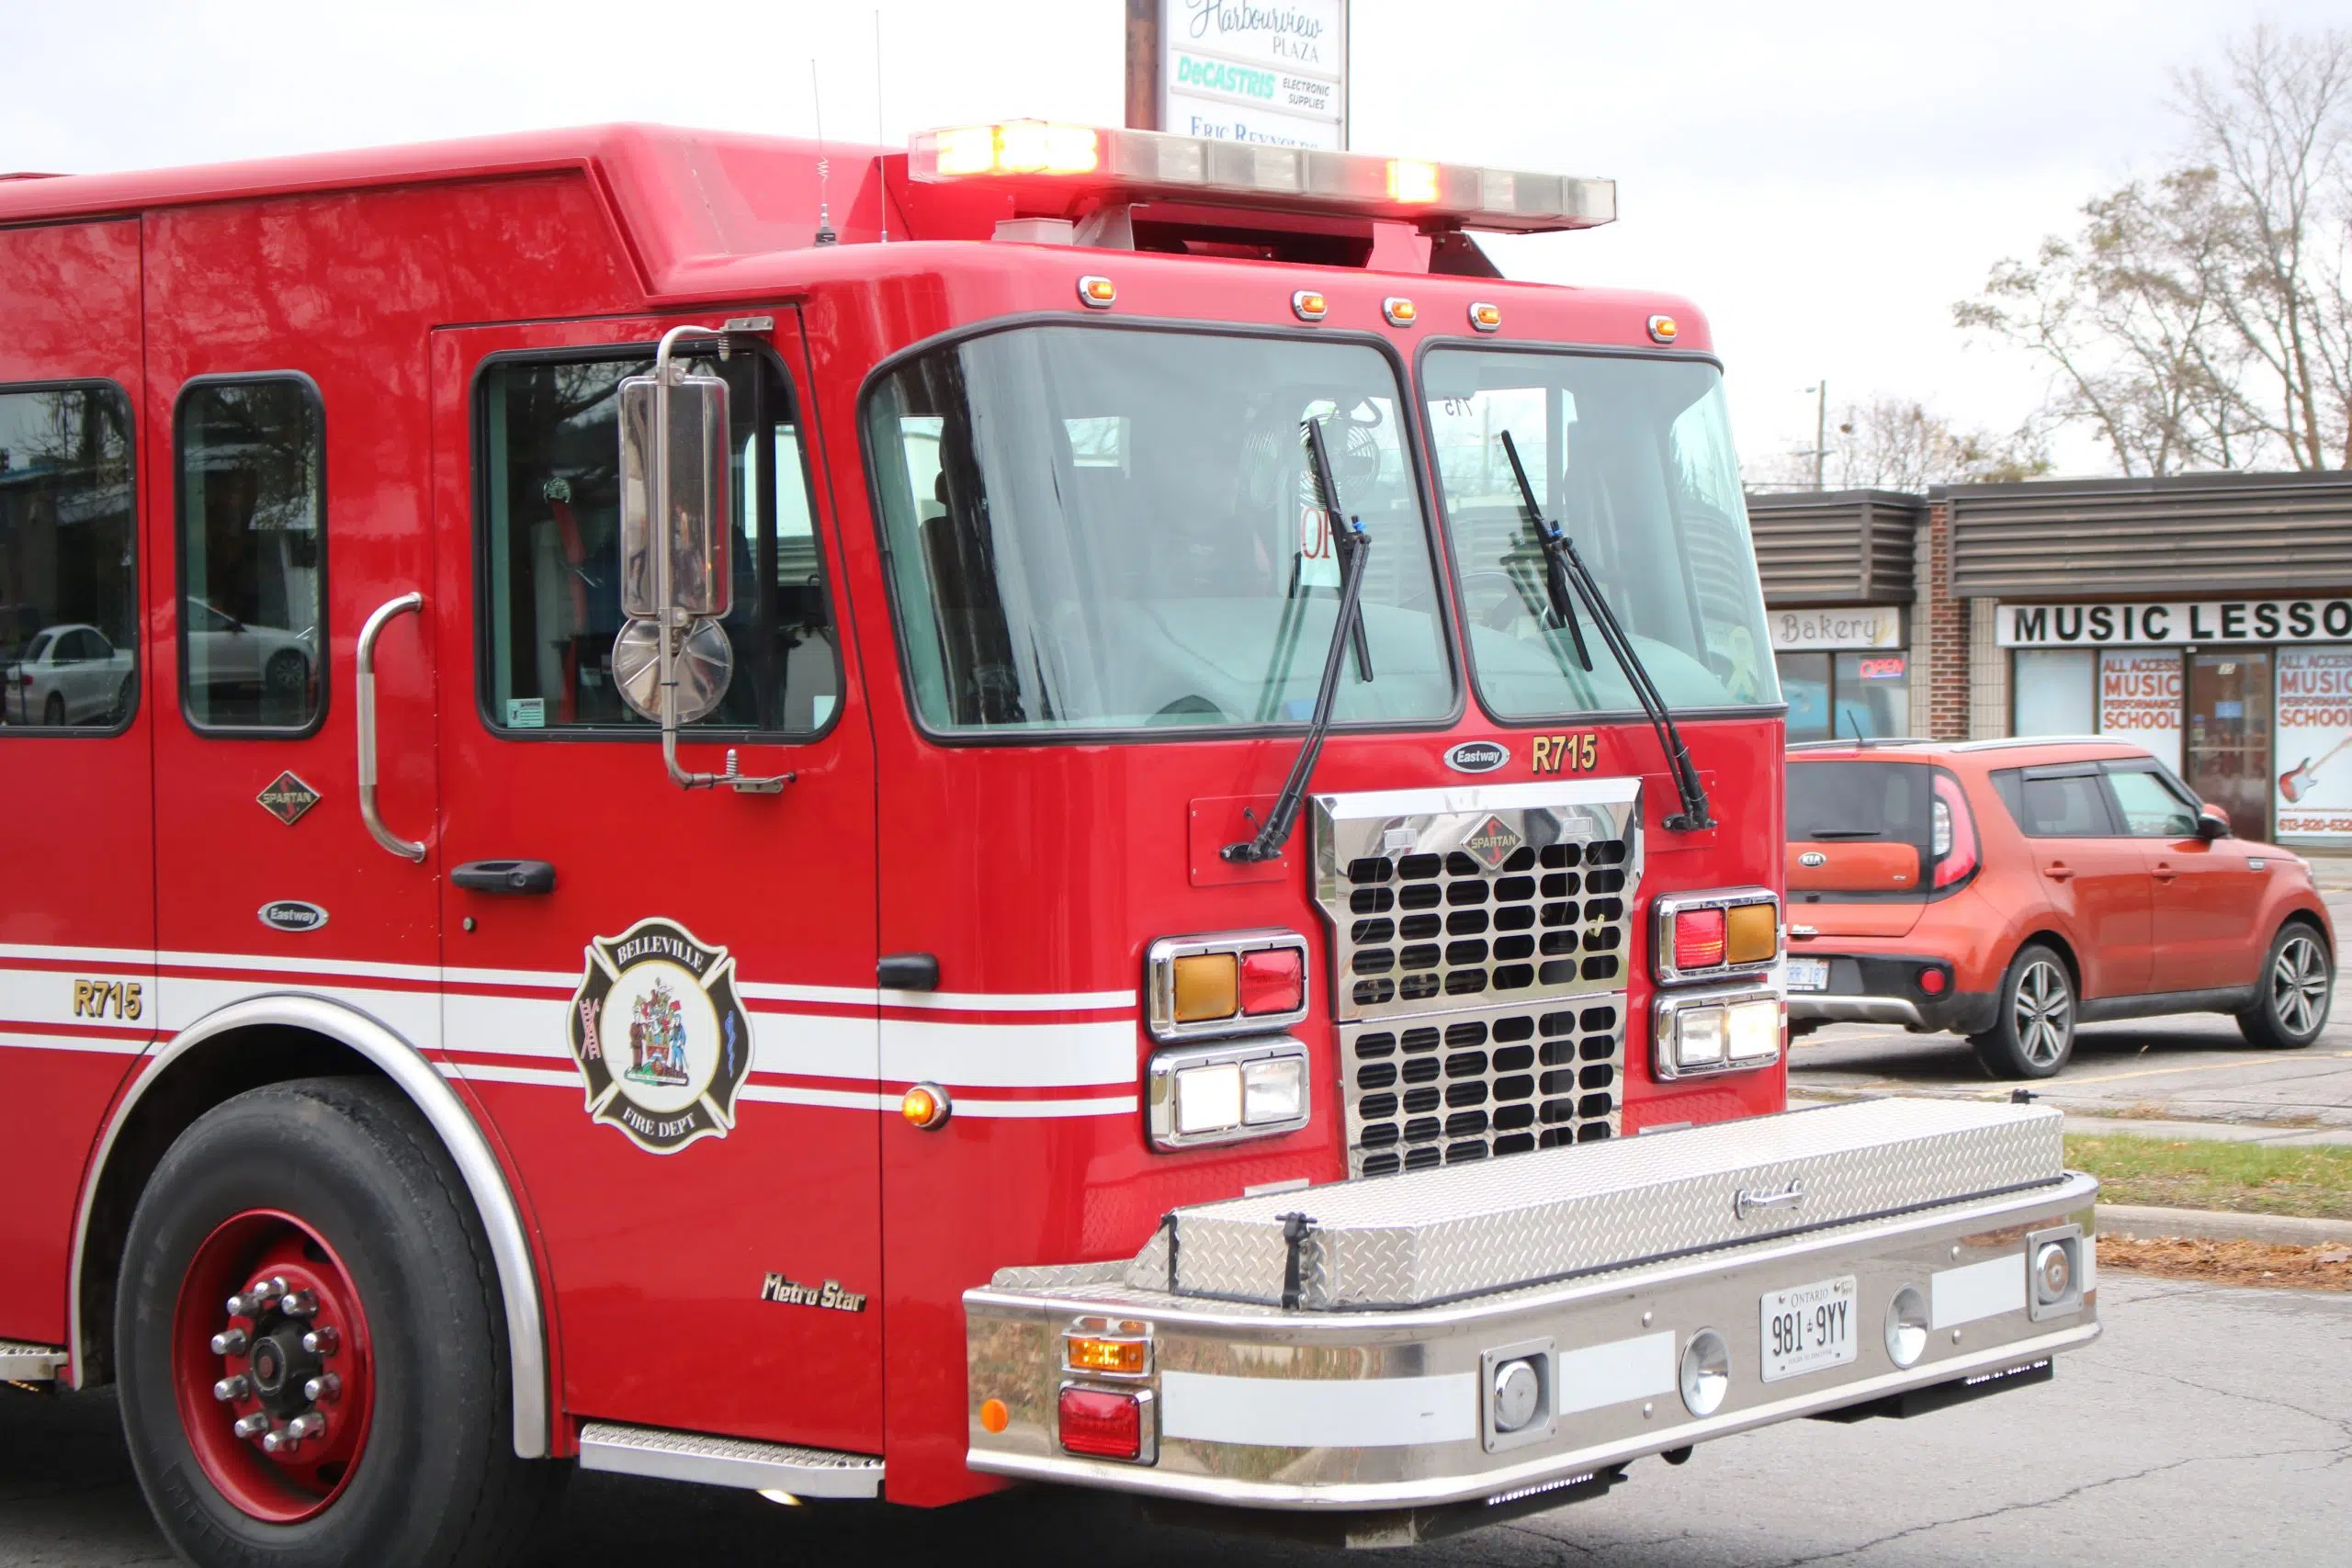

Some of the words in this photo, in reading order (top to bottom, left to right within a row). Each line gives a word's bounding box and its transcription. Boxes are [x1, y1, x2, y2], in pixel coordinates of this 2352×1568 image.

[1272, 36, 1319, 63] PLAZA
[1178, 55, 1276, 99] DeCASTRIS
[1283, 77, 1330, 96] ELECTRONIC
[1288, 93, 1325, 110] SUPPLIES
[1191, 116, 1229, 139] ERIC
[1781, 614, 1878, 645] Bakery
[2014, 605, 2170, 641] MUSIC
[2190, 601, 2352, 638] LESSO
[1860, 658, 1905, 678] OPEN
[2103, 659, 2126, 672] ALL
[2130, 658, 2181, 671] ACCESS
[2104, 674, 2181, 696] MUSIC
[2104, 711, 2181, 729] SCHOOL
[1456, 750, 1500, 764] Eastway
[1532, 734, 1598, 773] R715
[263, 792, 312, 805] SPARTAN
[1471, 834, 1516, 850] SPARTAN
[269, 907, 317, 924] Eastway
[616, 935, 705, 973] BELLEVILLE
[74, 979, 142, 1021] R715
[622, 1106, 655, 1136] FIRE
[658, 1112, 695, 1138] DEPT
[761, 1271, 820, 1307] Metro
[820, 1279, 866, 1313] Star
[1791, 1288, 1829, 1308] ONTARIO
[1772, 1310, 1803, 1357] 981
[1816, 1300, 1848, 1346] 9YY
